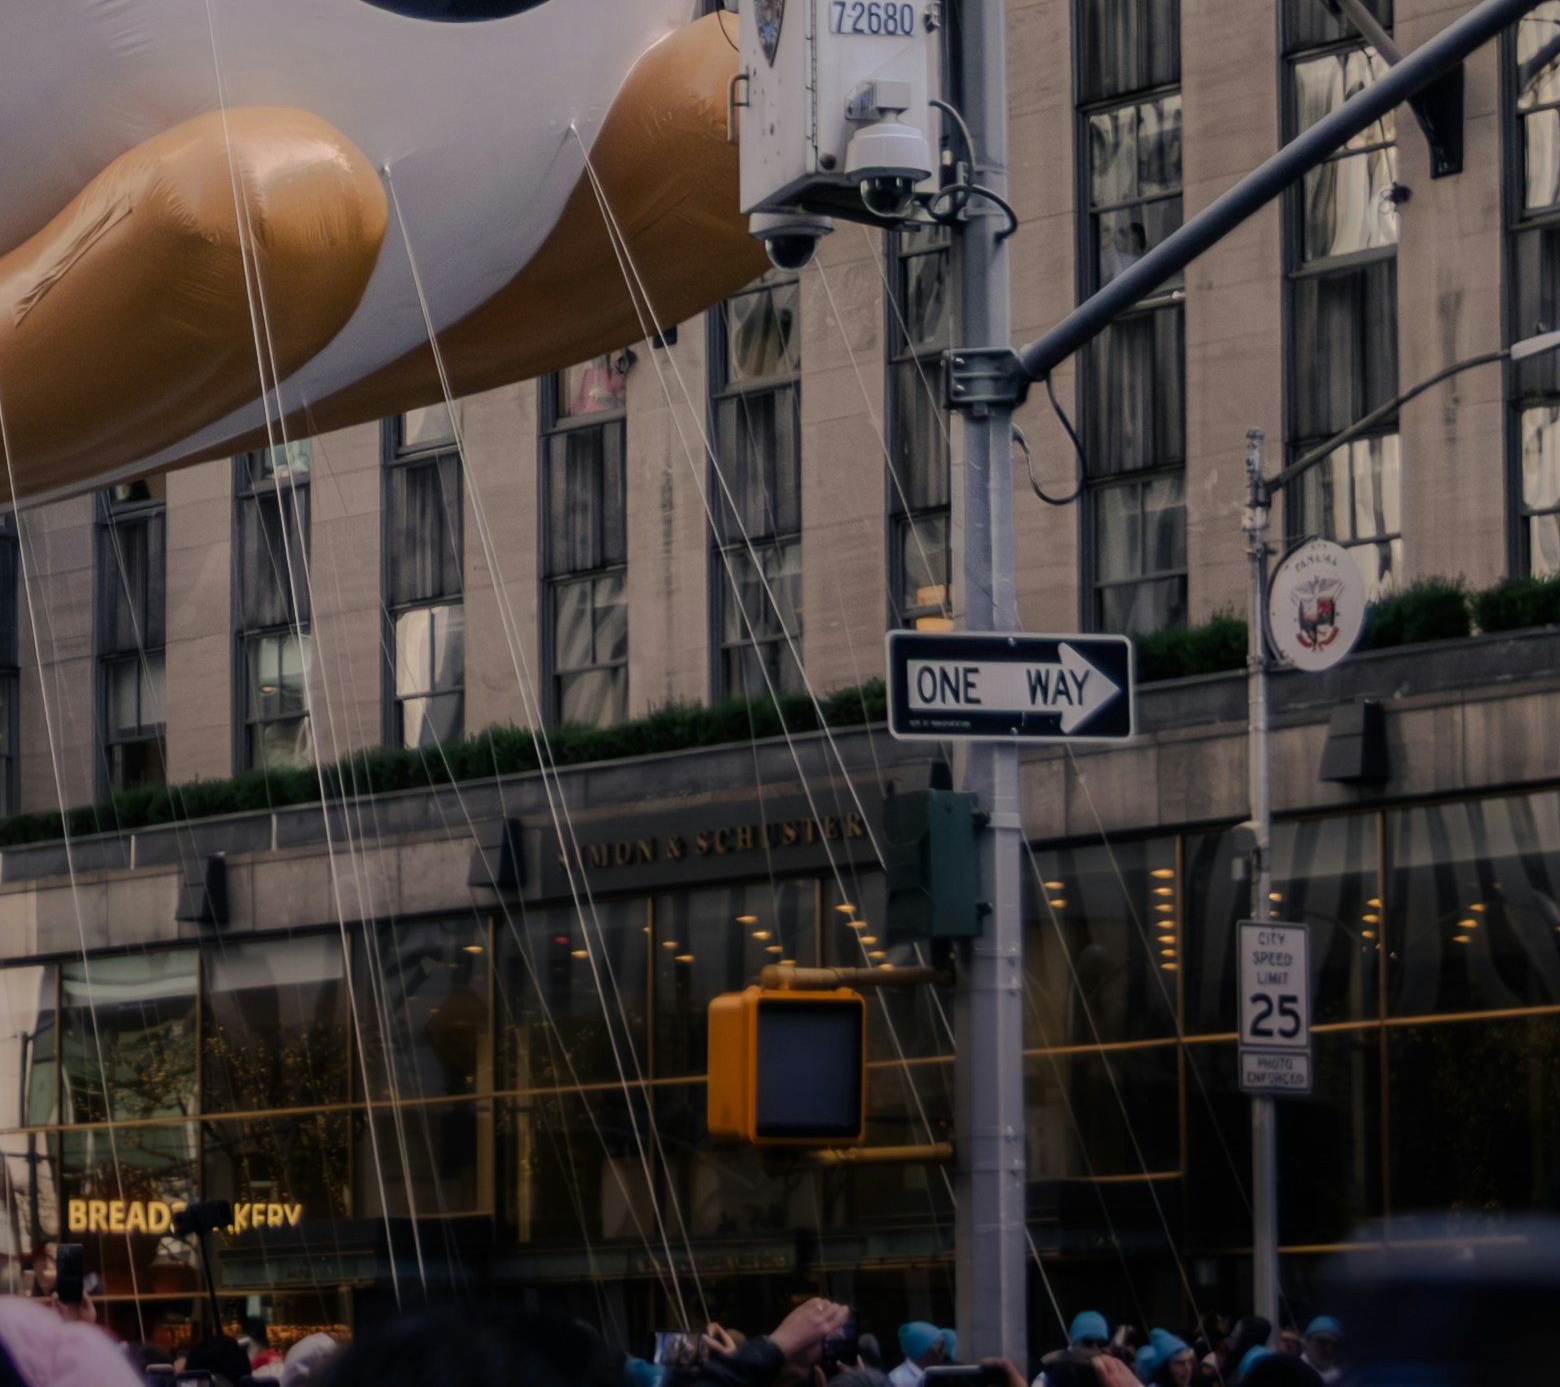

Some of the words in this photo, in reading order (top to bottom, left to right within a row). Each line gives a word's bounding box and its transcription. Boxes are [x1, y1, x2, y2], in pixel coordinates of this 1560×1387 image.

[832, 1, 914, 35] 7-2680
[916, 666, 981, 705] ONE
[1026, 669, 1090, 706] WAY
[665, 835, 684, 860] &
[694, 811, 863, 857] SCHUSTER
[1258, 931, 1285, 946] CITY
[1253, 950, 1293, 967] SPEED
[1257, 971, 1288, 986] LIMIT
[1250, 993, 1300, 1038] 25
[1257, 1057, 1293, 1071] PHOTO
[1246, 1070, 1305, 1086] ENFORCED
